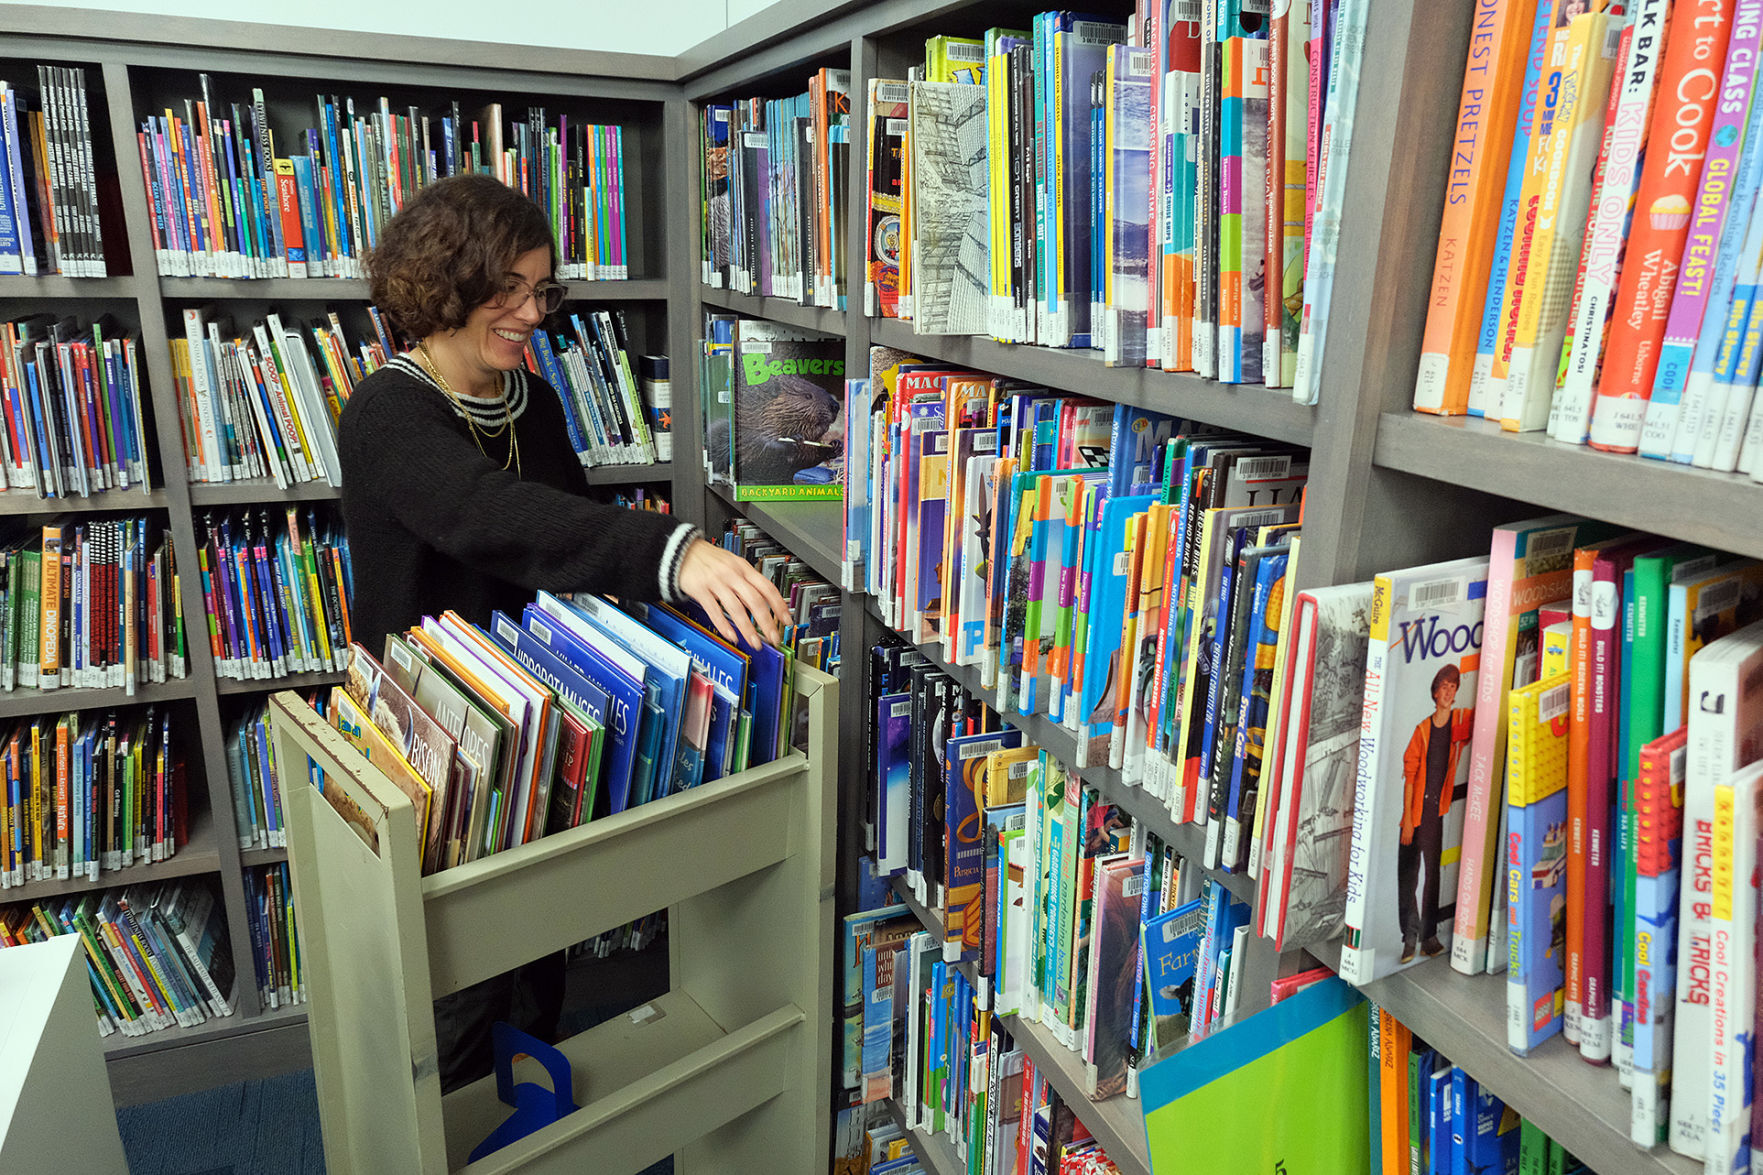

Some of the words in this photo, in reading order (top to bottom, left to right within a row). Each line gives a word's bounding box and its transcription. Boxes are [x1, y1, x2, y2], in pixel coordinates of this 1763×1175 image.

[1734, 0, 1762, 40] ING
[1149, 16, 1157, 74] MACAULAY
[1692, 33, 1715, 61] to
[1628, 33, 1652, 94] BAR:
[1719, 45, 1754, 116] CLASS
[1308, 50, 1318, 144] CONSTRUCTION
[1520, 76, 1540, 136] SOUP
[256, 101, 268, 145] EYEWITNESS
[262, 146, 272, 170] BOOKS
[1601, 125, 1614, 156] KIDS
[1662, 64, 1719, 183] Cook
[1448, 86, 1483, 205] PRETZELS
[1605, 98, 1644, 189] KIDS
[1307, 146, 1315, 200] VEHICLES
[1543, 127, 1567, 211] COOKBOOK
[1598, 160, 1607, 175] IN
[185, 196, 193, 218] CORAL
[279, 178, 292, 212] Seashore
[1036, 184, 1044, 212] INSIDE
[1592, 179, 1603, 206] THE
[1696, 156, 1730, 230] GLOBAL
[1501, 198, 1518, 251] KATZEN
[1580, 209, 1597, 266] HOLIDAY
[1588, 193, 1626, 285] ONLY
[1013, 223, 1021, 267] BOMBERS
[1498, 254, 1508, 264] &
[1534, 234, 1547, 260] Easy
[1435, 237, 1456, 307] KATZEN
[1681, 232, 1713, 297] FEAST!
[1711, 251, 1730, 296] Recipes
[1568, 272, 1585, 328] KITCHEN
[1626, 246, 1662, 331] Wheatley
[1646, 258, 1681, 322] Abigail
[1483, 267, 1505, 347] HENDERSON
[1522, 292, 1536, 331] Recipes
[1581, 295, 1598, 349] CHRISTINA
[191, 340, 202, 365] ANIMAL
[537, 337, 547, 348] Big
[541, 349, 552, 366] Book
[196, 368, 205, 387] BOOK
[549, 372, 558, 384] Sea
[742, 353, 844, 386] Beavers
[1576, 351, 1587, 374] TOSI
[1630, 337, 1652, 385] Usborne
[200, 399, 211, 427] JENKINS
[265, 356, 279, 384] SCOOP
[275, 389, 289, 418] Animal
[284, 417, 297, 443] POOP!
[1108, 422, 1118, 467] MACHINES
[741, 487, 796, 497] BACKYARD
[799, 486, 845, 496] ANIMALS
[1179, 473, 1189, 518] MACHINES
[1185, 503, 1195, 541] RED-HOT
[1194, 510, 1205, 549] RED-HOT
[1175, 534, 1183, 558] WORK
[1182, 542, 1191, 568] BIKES
[1190, 550, 1200, 575] BIKES
[45, 560, 56, 607] ULTIMATE
[1187, 586, 1196, 609] BMW
[1372, 585, 1384, 623] McGuire
[1487, 578, 1504, 649] WOODSHOP
[45, 610, 56, 663] DINOPEDIA
[1155, 629, 1166, 662] MONSTER
[1578, 627, 1586, 648] BUILD
[1596, 640, 1605, 661] BUILD
[1210, 642, 1220, 677] CHEVROLET
[1373, 656, 1381, 668] THE
[1484, 652, 1496, 670] for
[1578, 650, 1586, 659] IT!
[1596, 663, 1604, 672] IT!
[1150, 663, 1161, 709] BULLDOZERS
[1159, 670, 1168, 704] GIFFORD
[1206, 678, 1216, 709] CORVETTE
[1480, 672, 1495, 703] KIDS
[1577, 661, 1585, 694] MEDIEVAL
[1595, 674, 1604, 712] MONSTERS
[1237, 696, 1248, 728] STOCK
[1360, 669, 1380, 733] All-New
[1576, 696, 1584, 721] WORLD
[410, 733, 441, 791] BISON
[1234, 731, 1245, 758] CARS
[1473, 753, 1486, 781] JACK
[57, 777, 66, 800] Answers
[1350, 736, 1375, 841] Woodworking
[1469, 783, 1483, 821] McKEE
[1061, 852, 1072, 878] first
[1349, 844, 1366, 866] for
[1508, 832, 1521, 864] Cool
[1694, 819, 1712, 893] BRICKS
[1049, 848, 1059, 902] GARDENING
[1144, 854, 1152, 878] GROW
[1346, 870, 1363, 904] Kids
[1508, 869, 1521, 902] Cars
[1047, 904, 1056, 947] PROJECTS
[1056, 880, 1069, 947] gardening
[1693, 901, 1710, 920] &
[1205, 926, 1213, 948] Tales
[1508, 930, 1522, 977] Trucks
[1636, 931, 1651, 965] Cool
[1715, 930, 1728, 965] Cool
[1056, 950, 1066, 980] book
[1135, 945, 1143, 983] TOMATOES
[1200, 955, 1209, 991] Famous
[1570, 952, 1579, 980] GRAPHIC
[1687, 931, 1708, 1004] TRICKS
[1587, 976, 1596, 1005] GRAPHIC
[1634, 968, 1650, 1024] Castles
[1713, 971, 1728, 1045] Creations
[1714, 1051, 1727, 1065] in
[1713, 1070, 1725, 1088] 35
